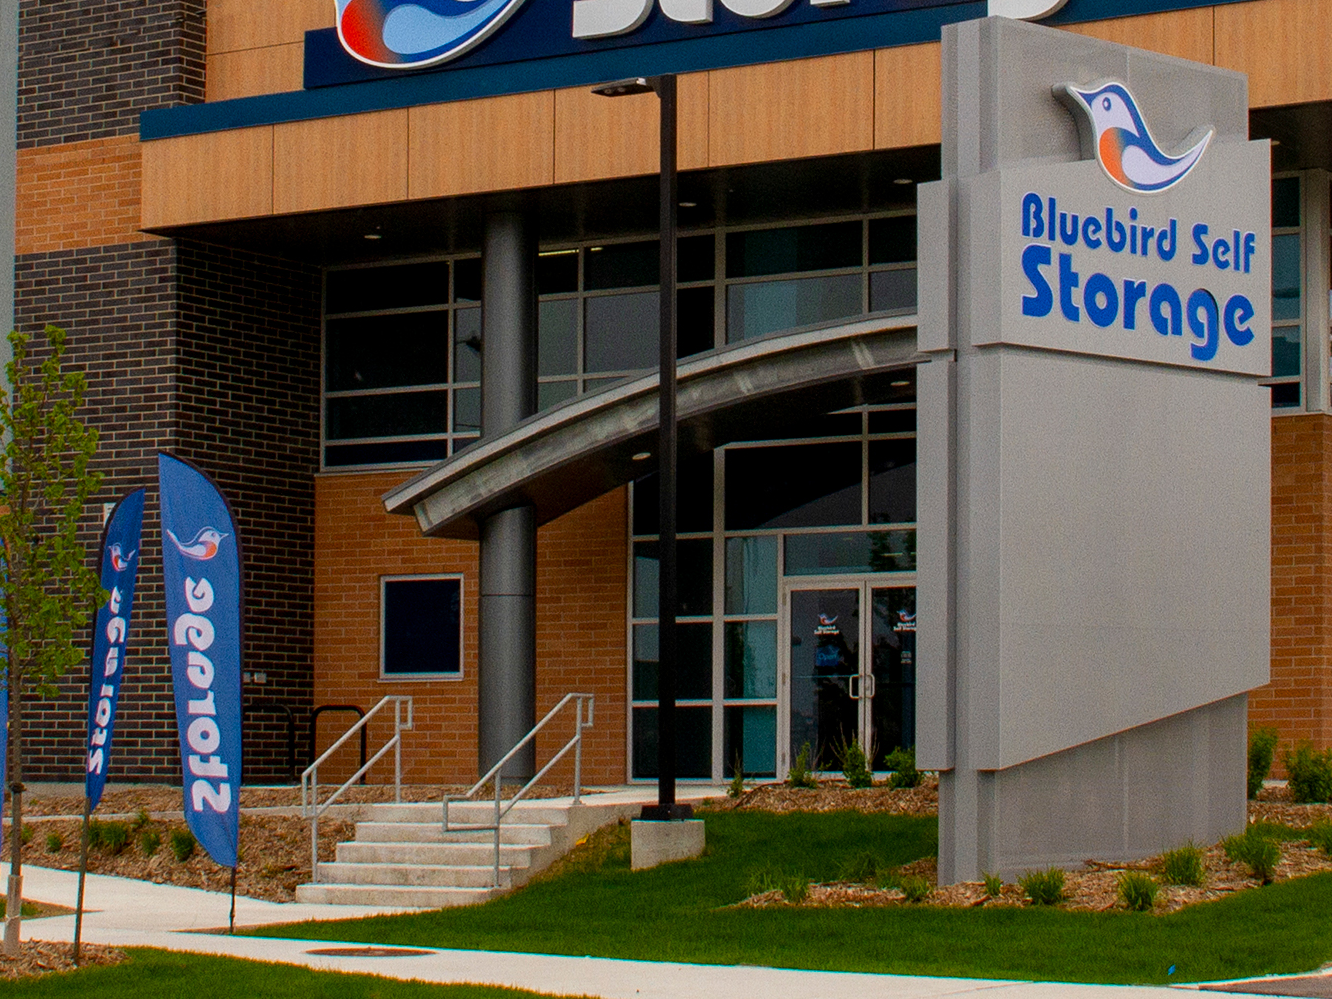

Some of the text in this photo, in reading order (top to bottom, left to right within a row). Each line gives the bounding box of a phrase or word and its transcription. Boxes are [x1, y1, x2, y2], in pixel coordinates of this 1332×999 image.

[1021, 192, 1256, 274] Bluebird Self
[1021, 243, 1256, 362] Storage
